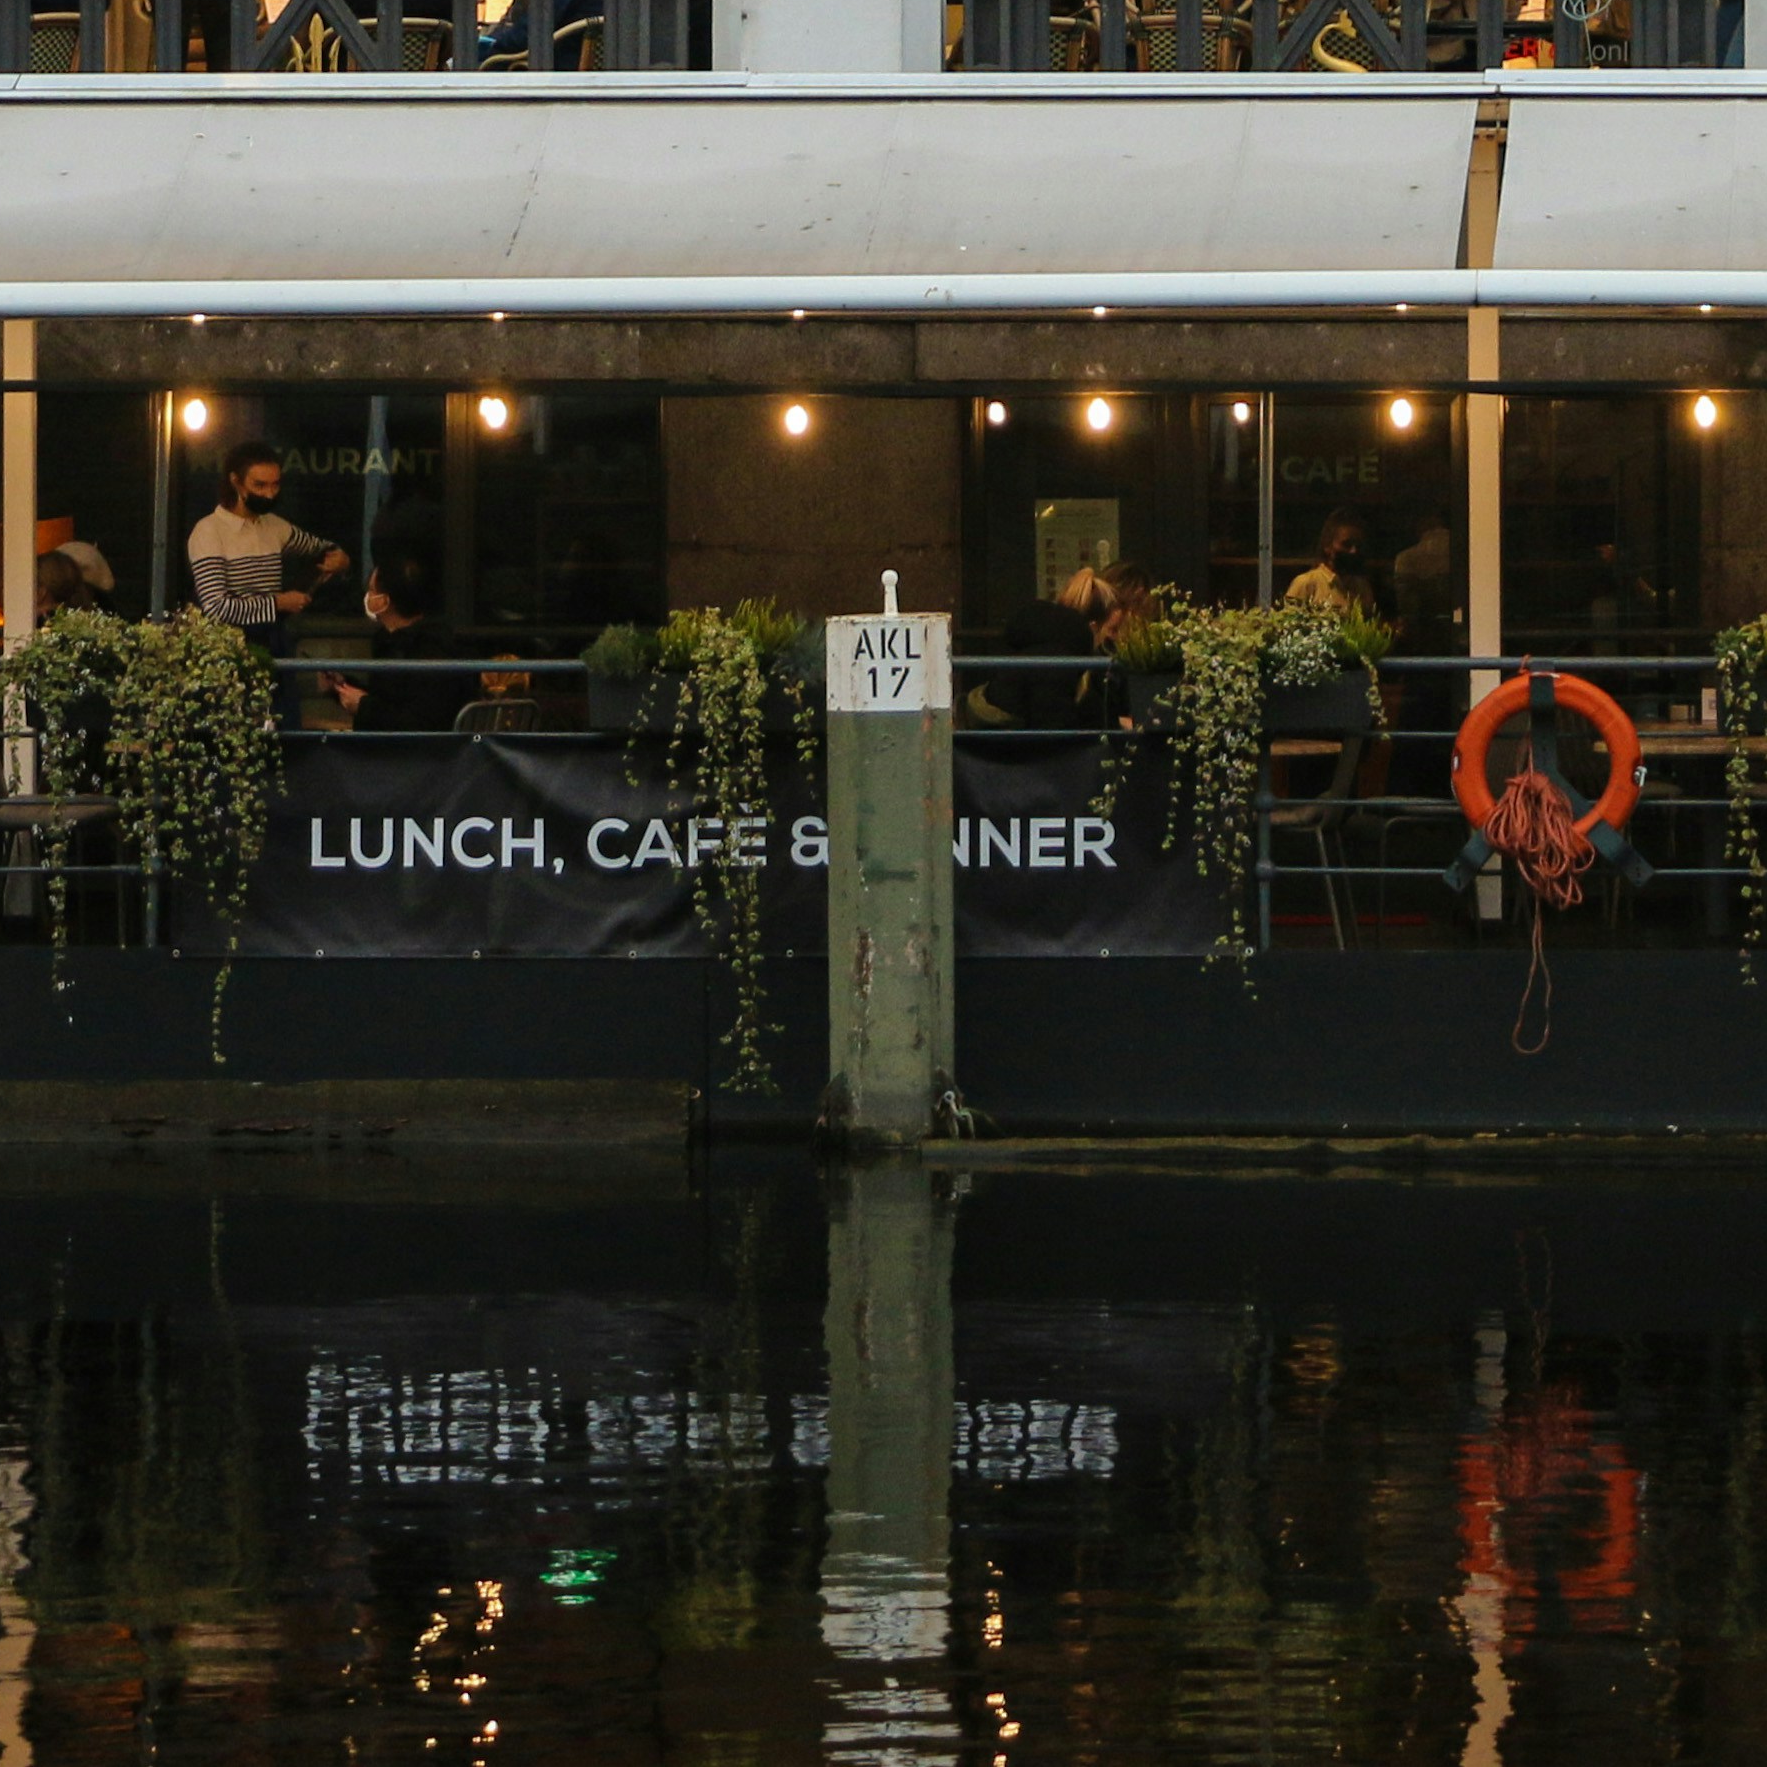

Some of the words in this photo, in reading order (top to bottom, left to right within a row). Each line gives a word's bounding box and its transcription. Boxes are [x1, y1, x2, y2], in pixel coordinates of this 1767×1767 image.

[1280, 448, 1380, 483] CAFÉ
[854, 627, 922, 661] AKL
[865, 665, 912, 700] 17
[310, 816, 565, 876] LUNCH,
[790, 816, 829, 869] &
